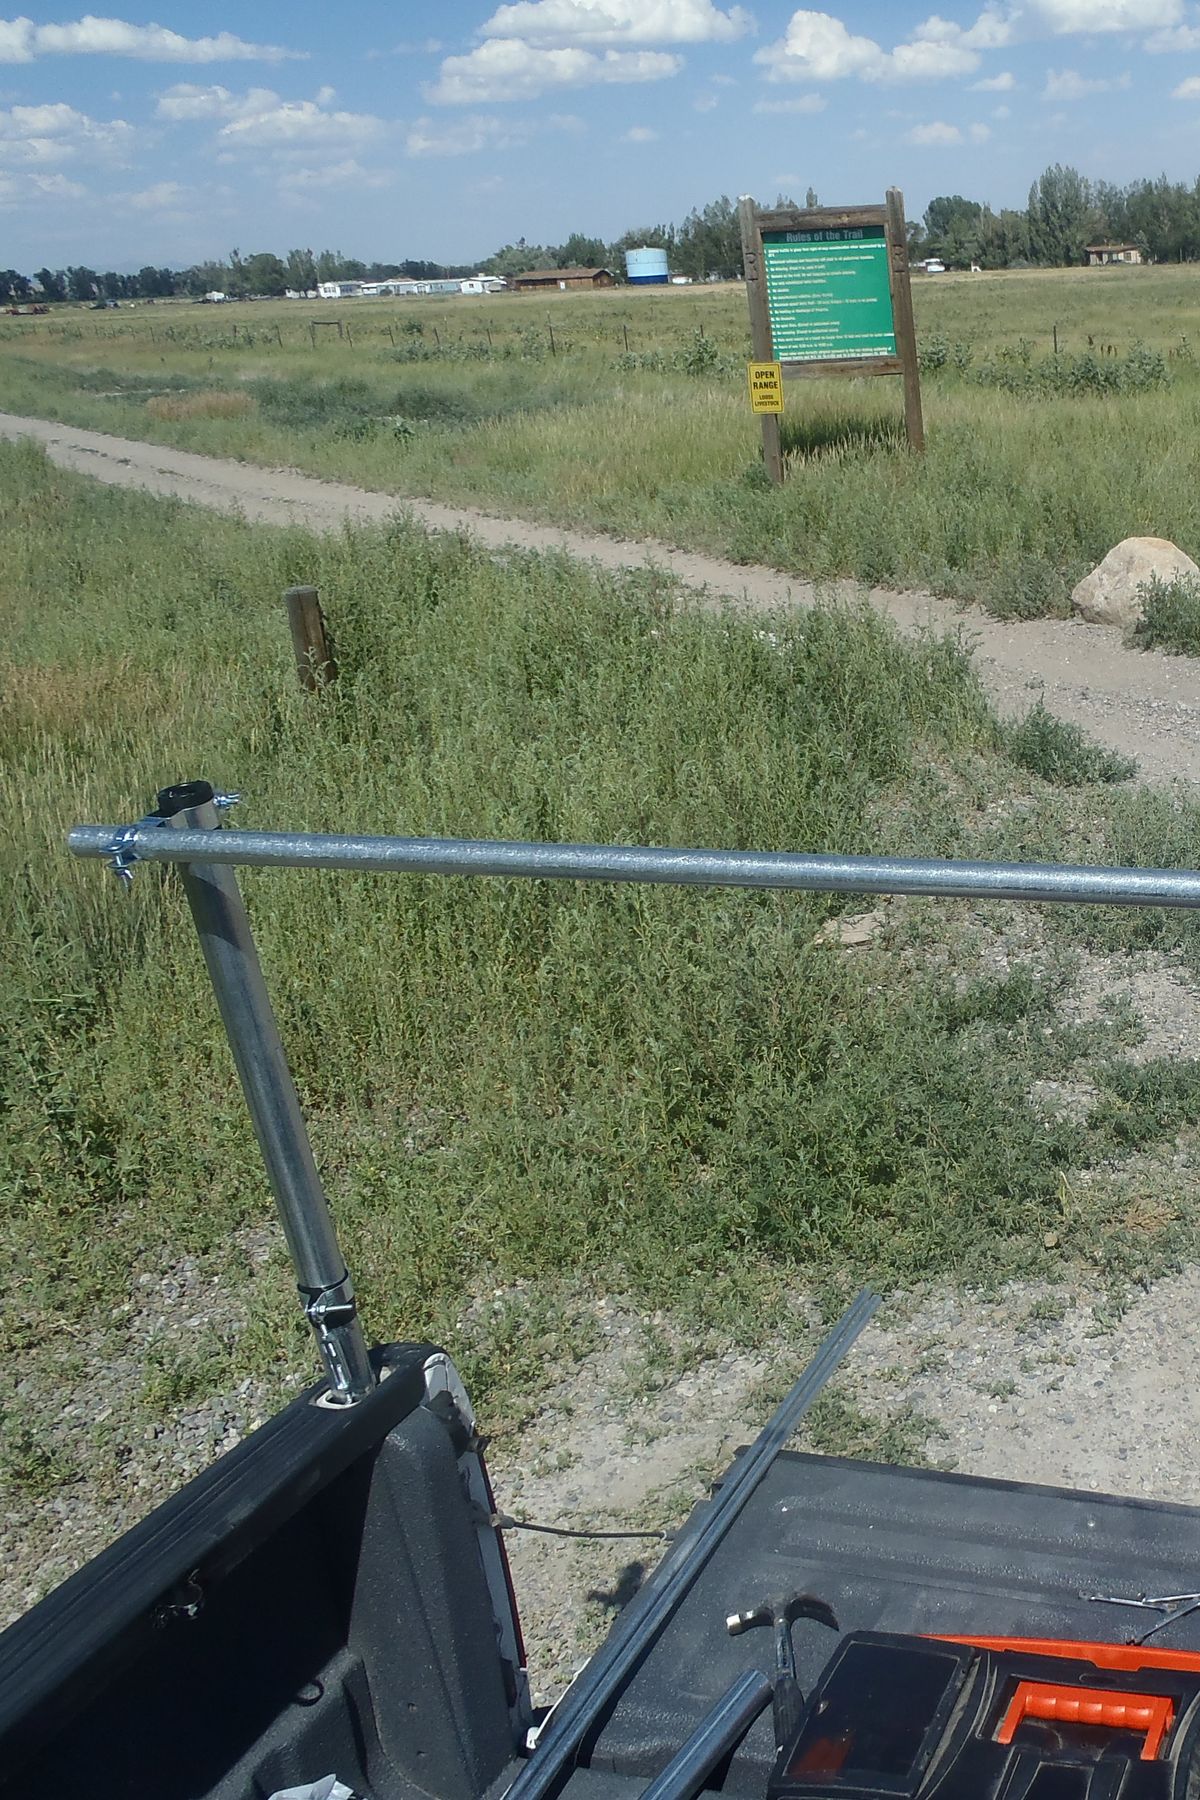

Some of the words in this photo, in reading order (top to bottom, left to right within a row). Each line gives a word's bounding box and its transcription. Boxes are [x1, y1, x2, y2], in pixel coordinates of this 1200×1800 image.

[786, 232, 812, 242] Rules
[814, 232, 823, 241] of
[826, 231, 840, 241] the
[844, 229, 863, 239] Trail
[755, 371, 775, 379] OPEN
[753, 381, 778, 390] RANGE
